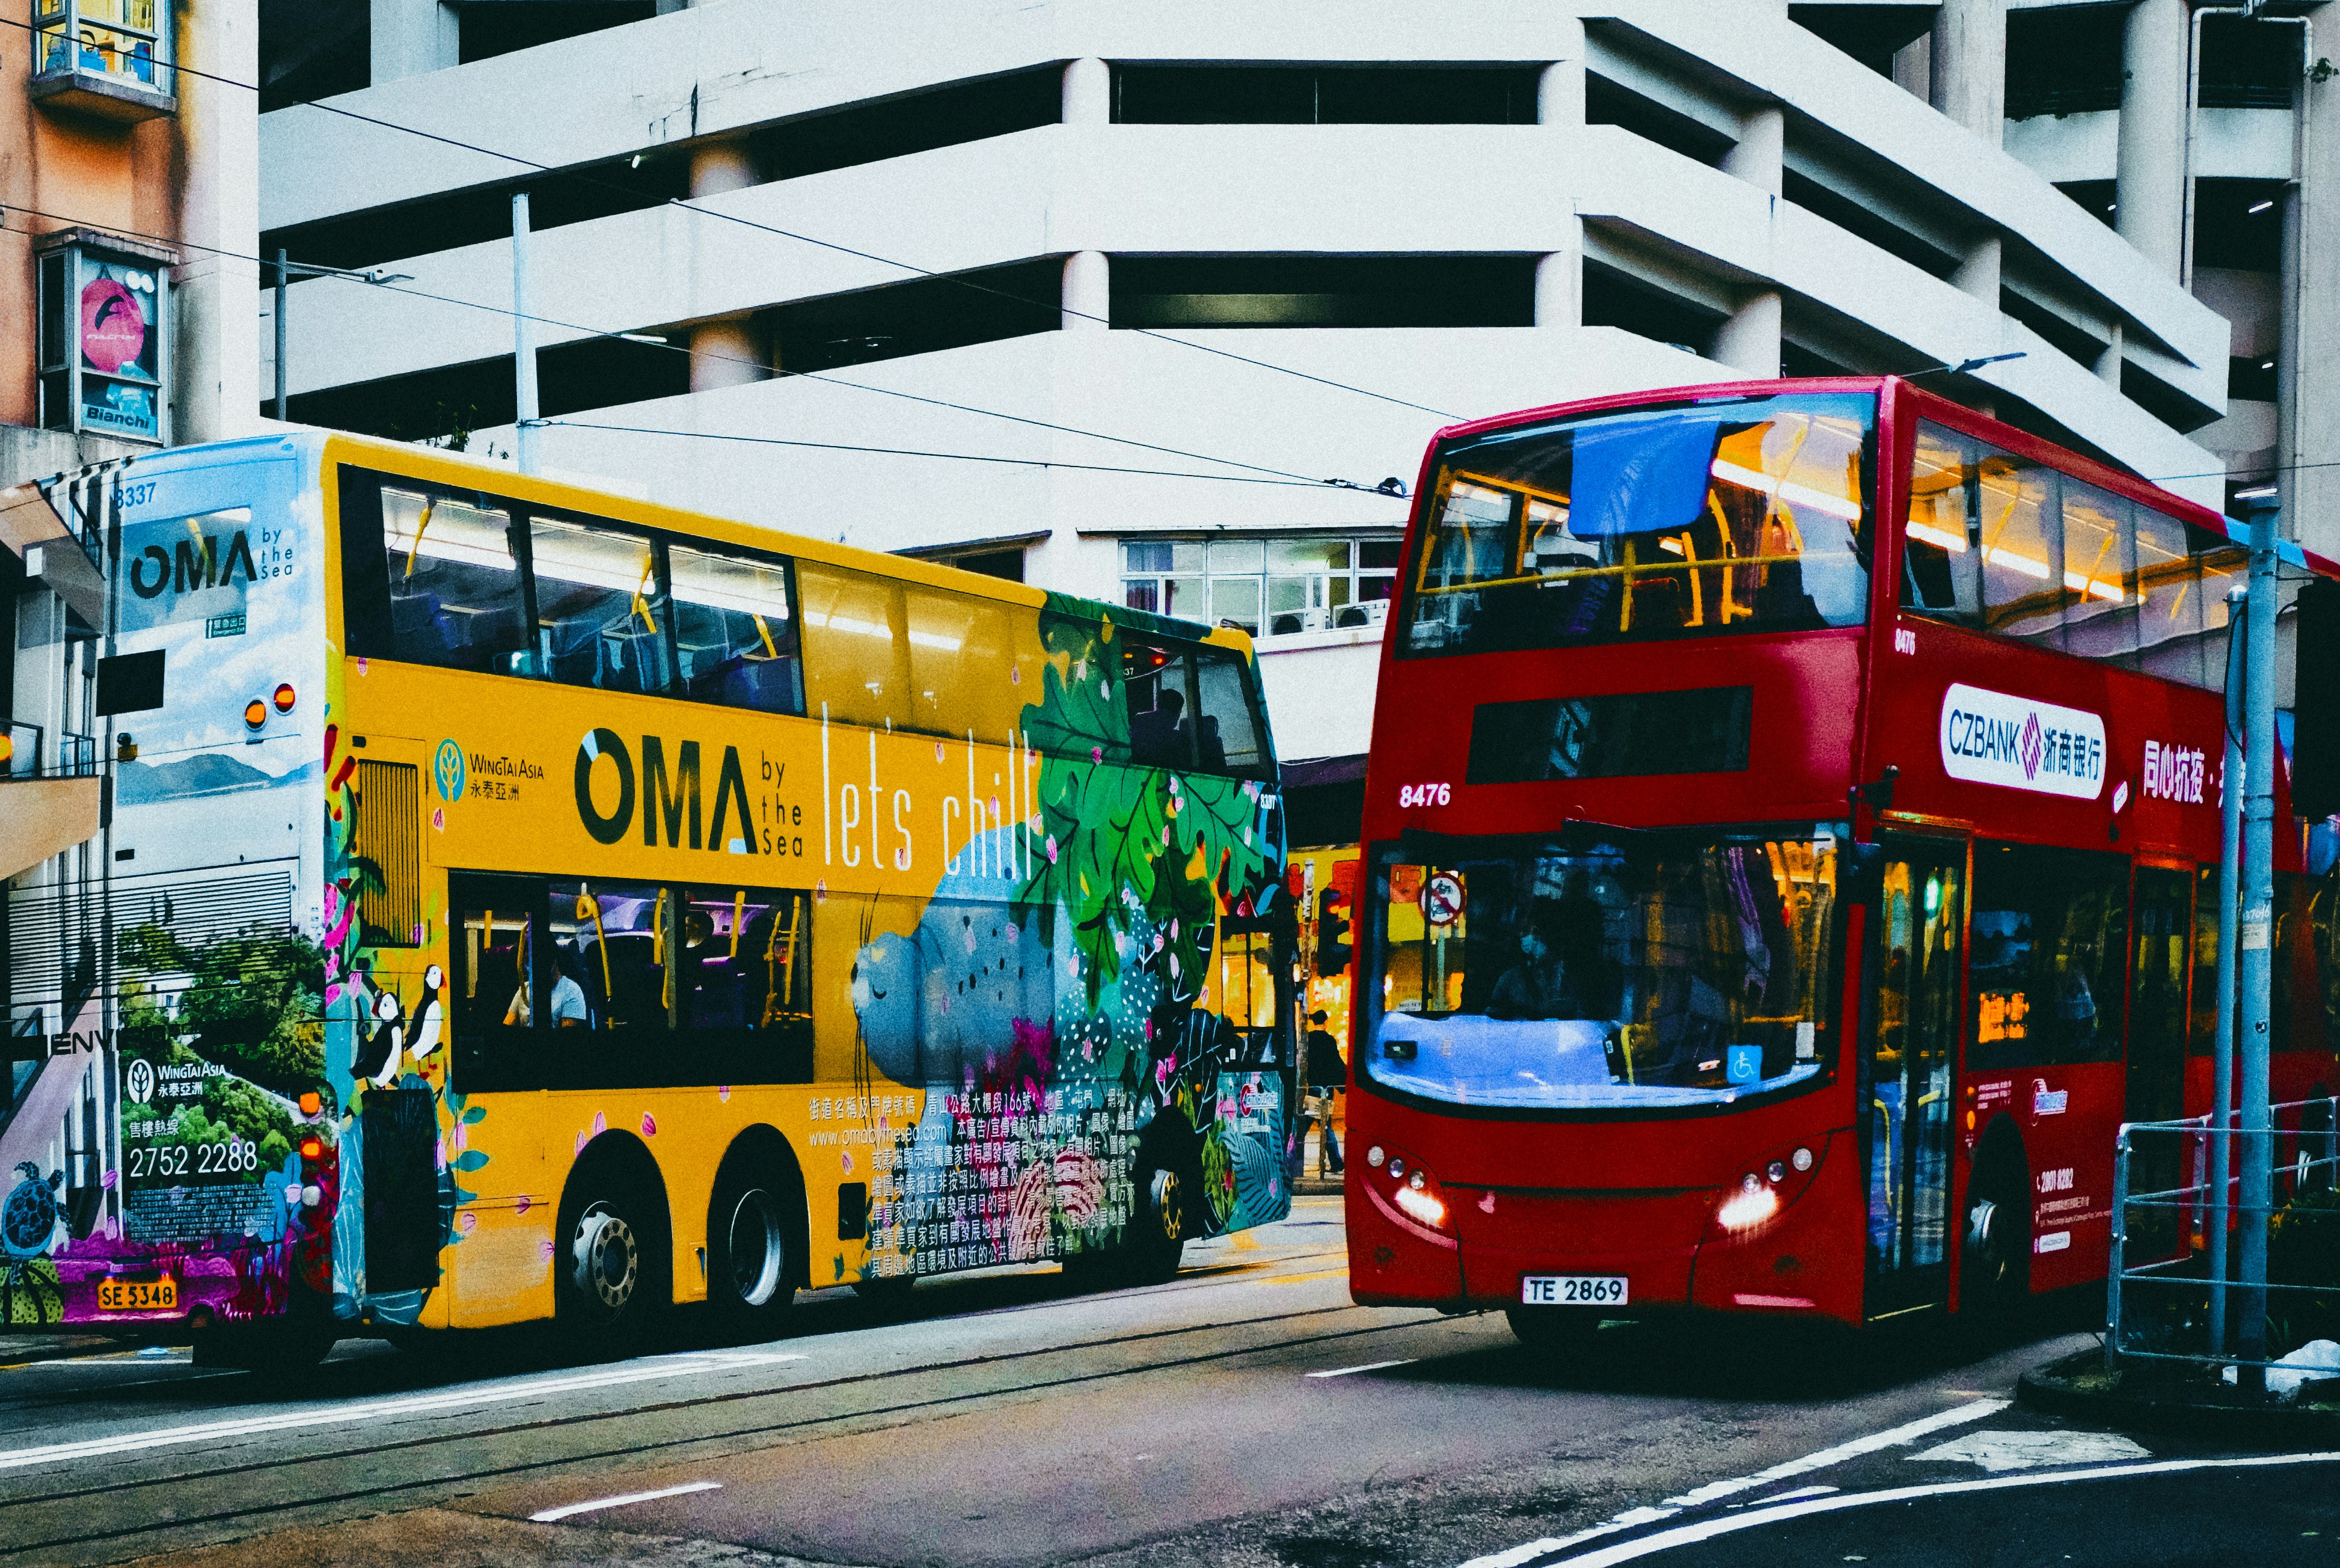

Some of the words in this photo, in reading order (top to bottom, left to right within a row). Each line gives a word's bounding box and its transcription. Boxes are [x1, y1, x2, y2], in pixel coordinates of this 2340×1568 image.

[87, 406, 150, 429] Bianchi
[262, 527, 281, 545] by
[130, 530, 258, 599] OMA
[261, 546, 293, 564] the
[1894, 628, 1916, 656] 8476
[1123, 667, 1134, 676] 37
[1949, 709, 2020, 765] CZBANK
[762, 750, 785, 789] by
[470, 780, 519, 801] 永泰亞洲
[574, 727, 759, 855] OMA
[1399, 782, 1451, 808] 8476
[762, 792, 801, 826] the
[943, 727, 1033, 881] chill
[158, 1081, 203, 1098] 永泰亞洲
[129, 1118, 179, 1138] 售樓熱線
[130, 1144, 189, 1177] 2752
[197, 1141, 257, 1172] 2288
[102, 1286, 123, 1306] SE
[128, 1285, 173, 1306] 5348
[1530, 1279, 1556, 1301] TE
[1564, 1279, 1622, 1301] 2869
